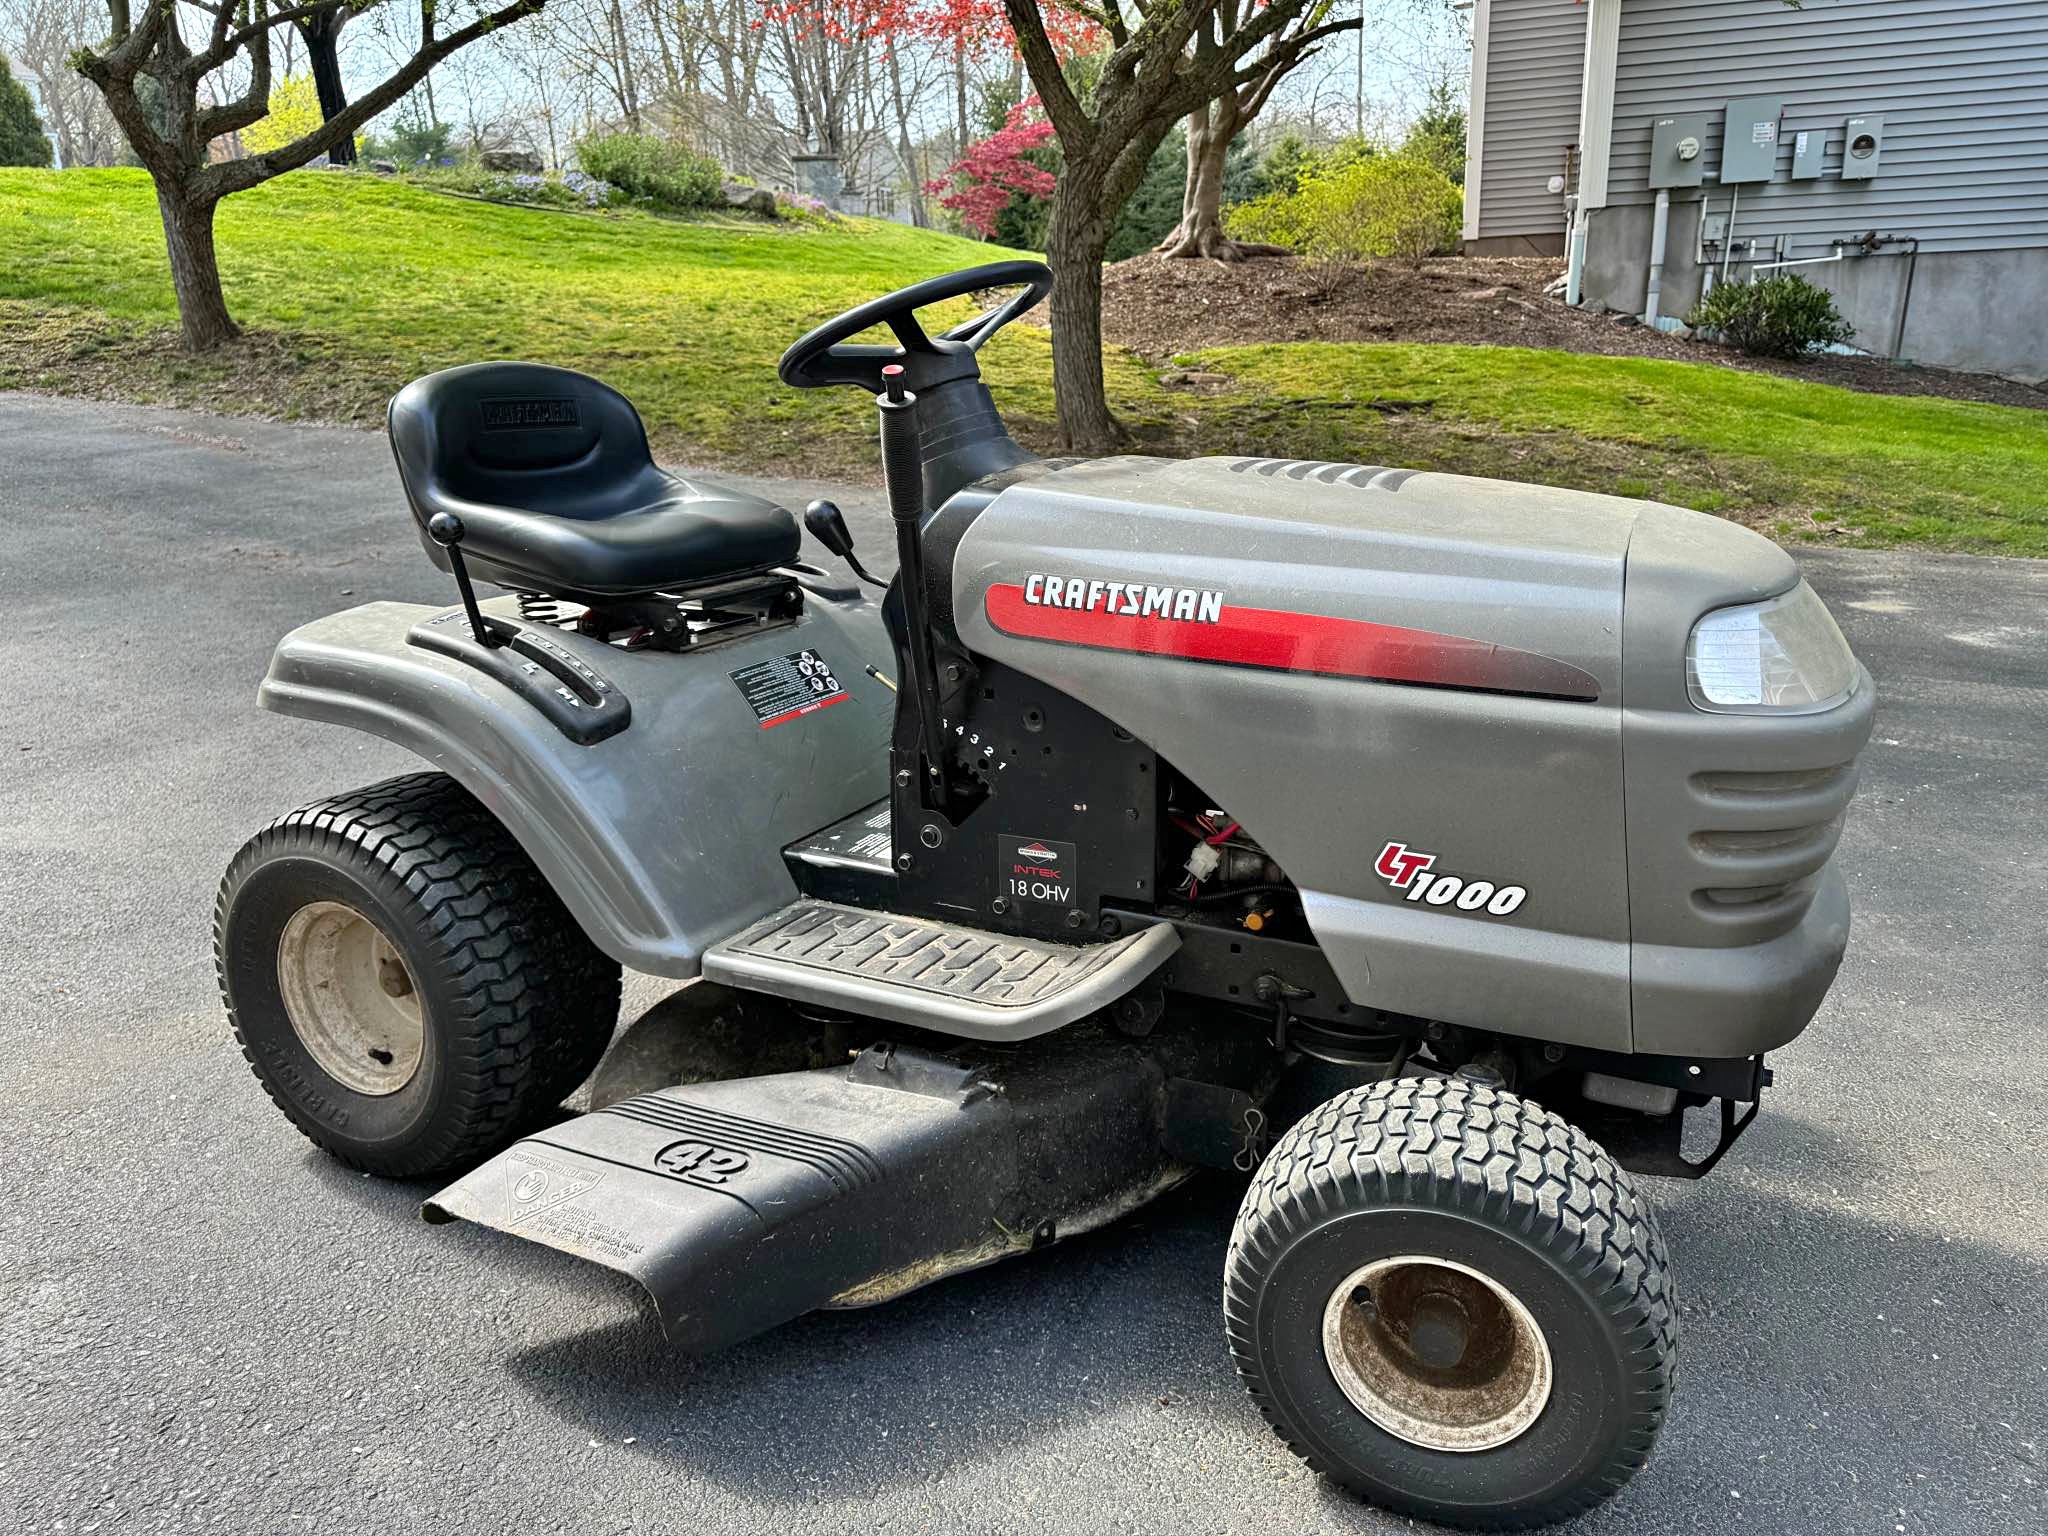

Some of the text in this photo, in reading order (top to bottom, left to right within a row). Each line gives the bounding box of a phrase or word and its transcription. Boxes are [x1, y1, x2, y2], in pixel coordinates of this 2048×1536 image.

[1024, 573, 1225, 624] CRAFTSMAN
[955, 725, 965, 736] 4
[969, 733, 979, 745] 3
[983, 745, 994, 757] 2
[1013, 863, 1062, 879] INTEK
[1009, 878, 1070, 903] 18 OHV
[659, 1146, 749, 1184] 42
[513, 1182, 583, 1220] DANGER
